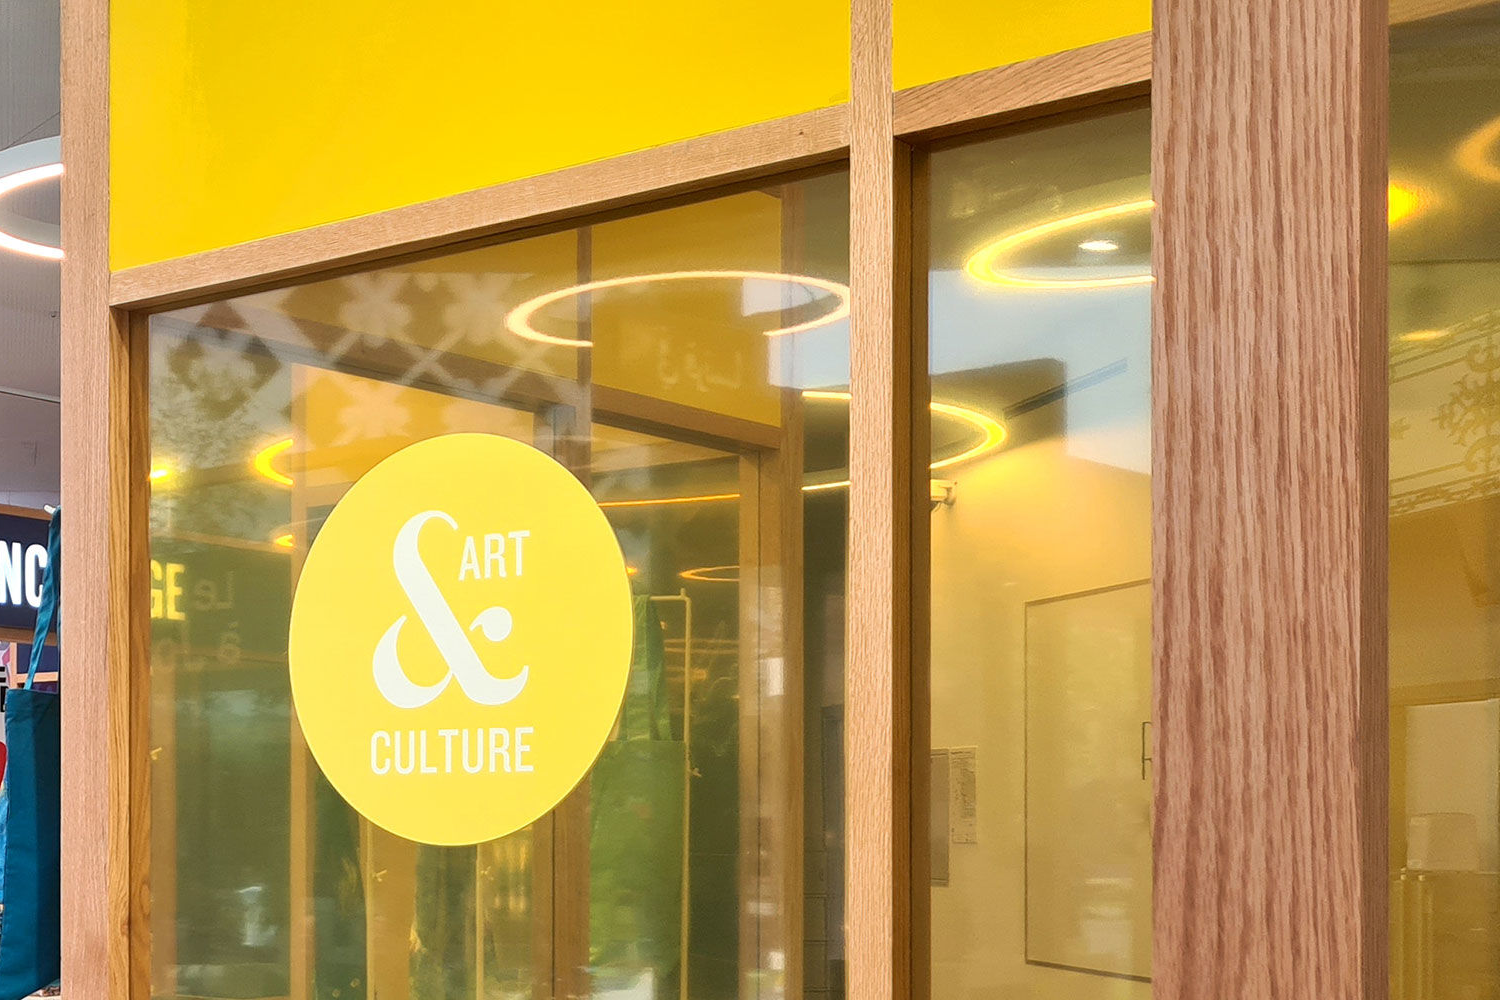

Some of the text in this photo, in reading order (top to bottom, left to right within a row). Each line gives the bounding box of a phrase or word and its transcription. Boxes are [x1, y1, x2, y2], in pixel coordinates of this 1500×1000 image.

[458, 530, 530, 581] ART
[372, 510, 529, 708] &
[371, 727, 534, 775] CULTURE
